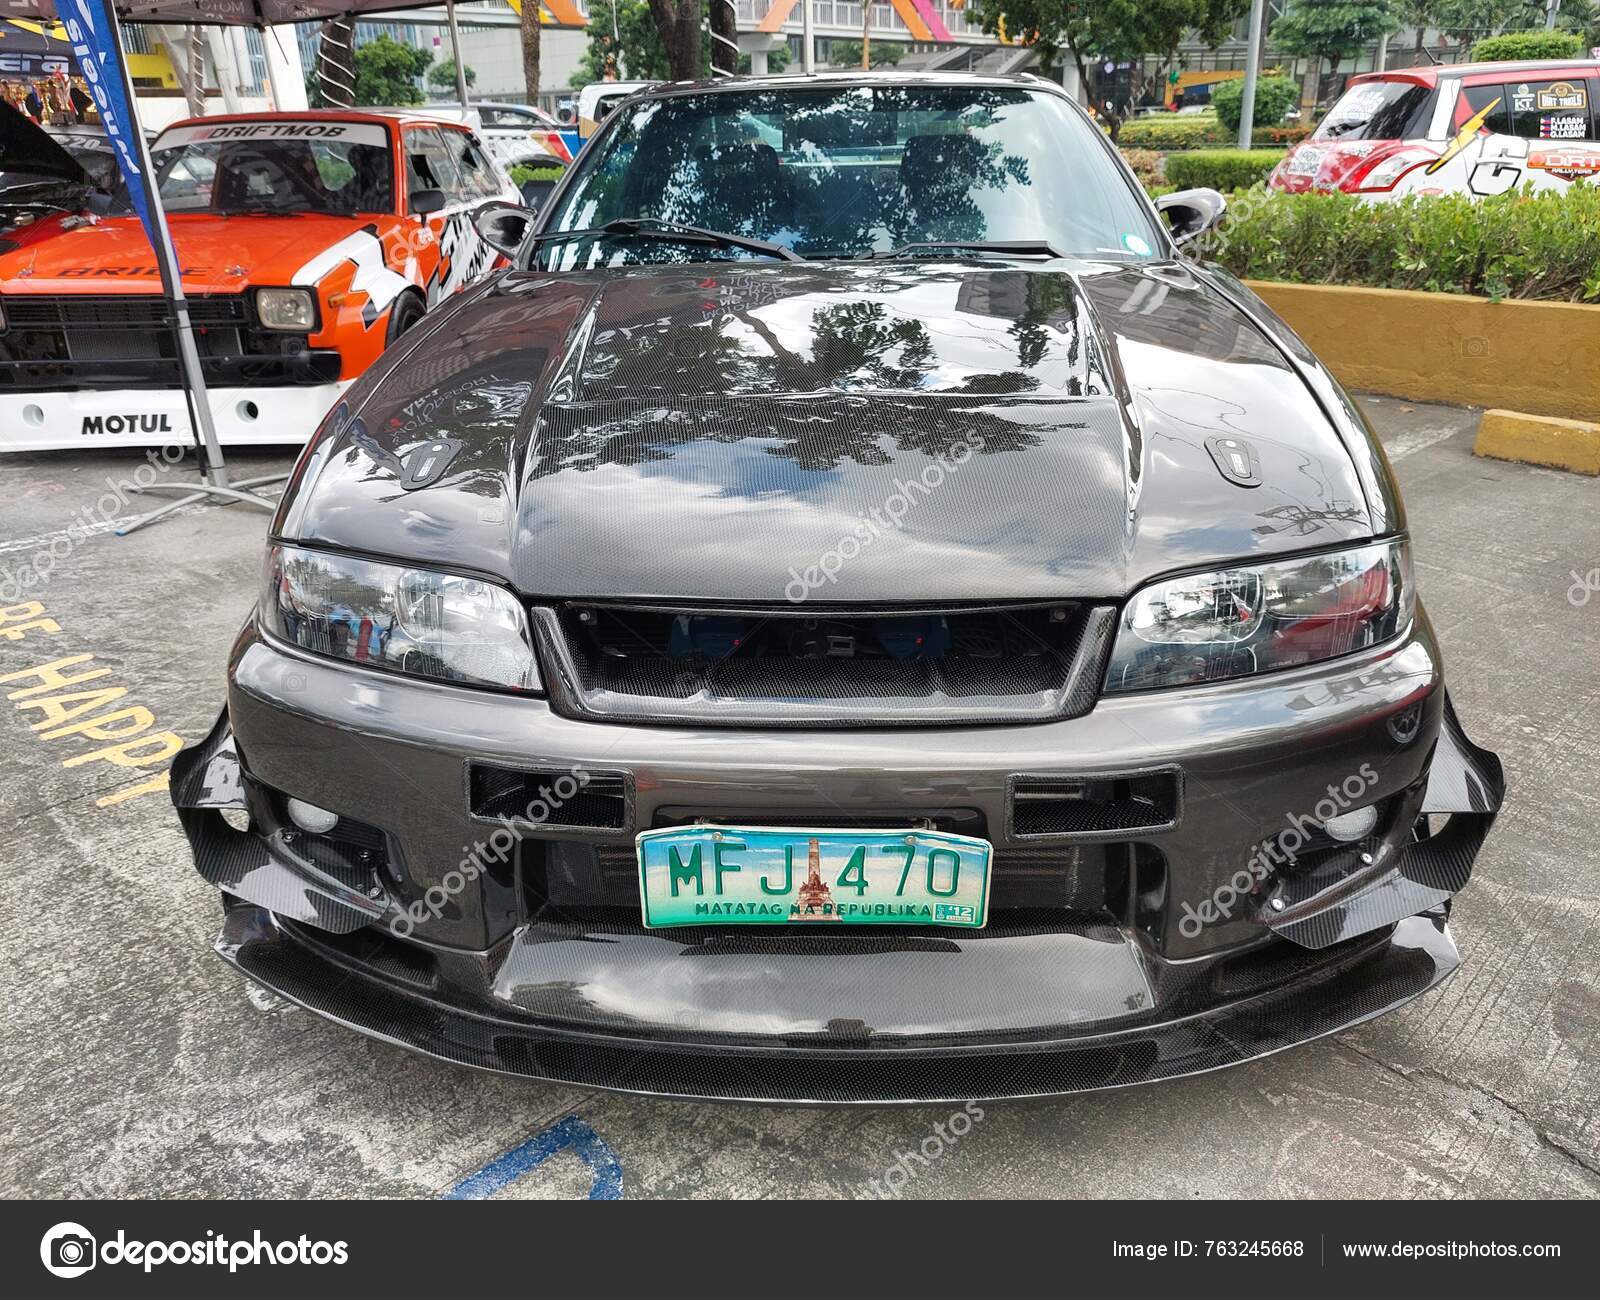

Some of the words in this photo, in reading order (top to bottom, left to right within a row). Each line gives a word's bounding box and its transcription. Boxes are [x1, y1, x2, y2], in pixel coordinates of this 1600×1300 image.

[207, 125, 347, 139] DRIFTMOB
[81, 413, 172, 435] MOTUL
[668, 842, 793, 897] MFJ
[836, 844, 962, 897] 470
[694, 902, 783, 916] MATATAG
[789, 902, 816, 916] NA
[822, 902, 932, 917] REPUBLIKA
